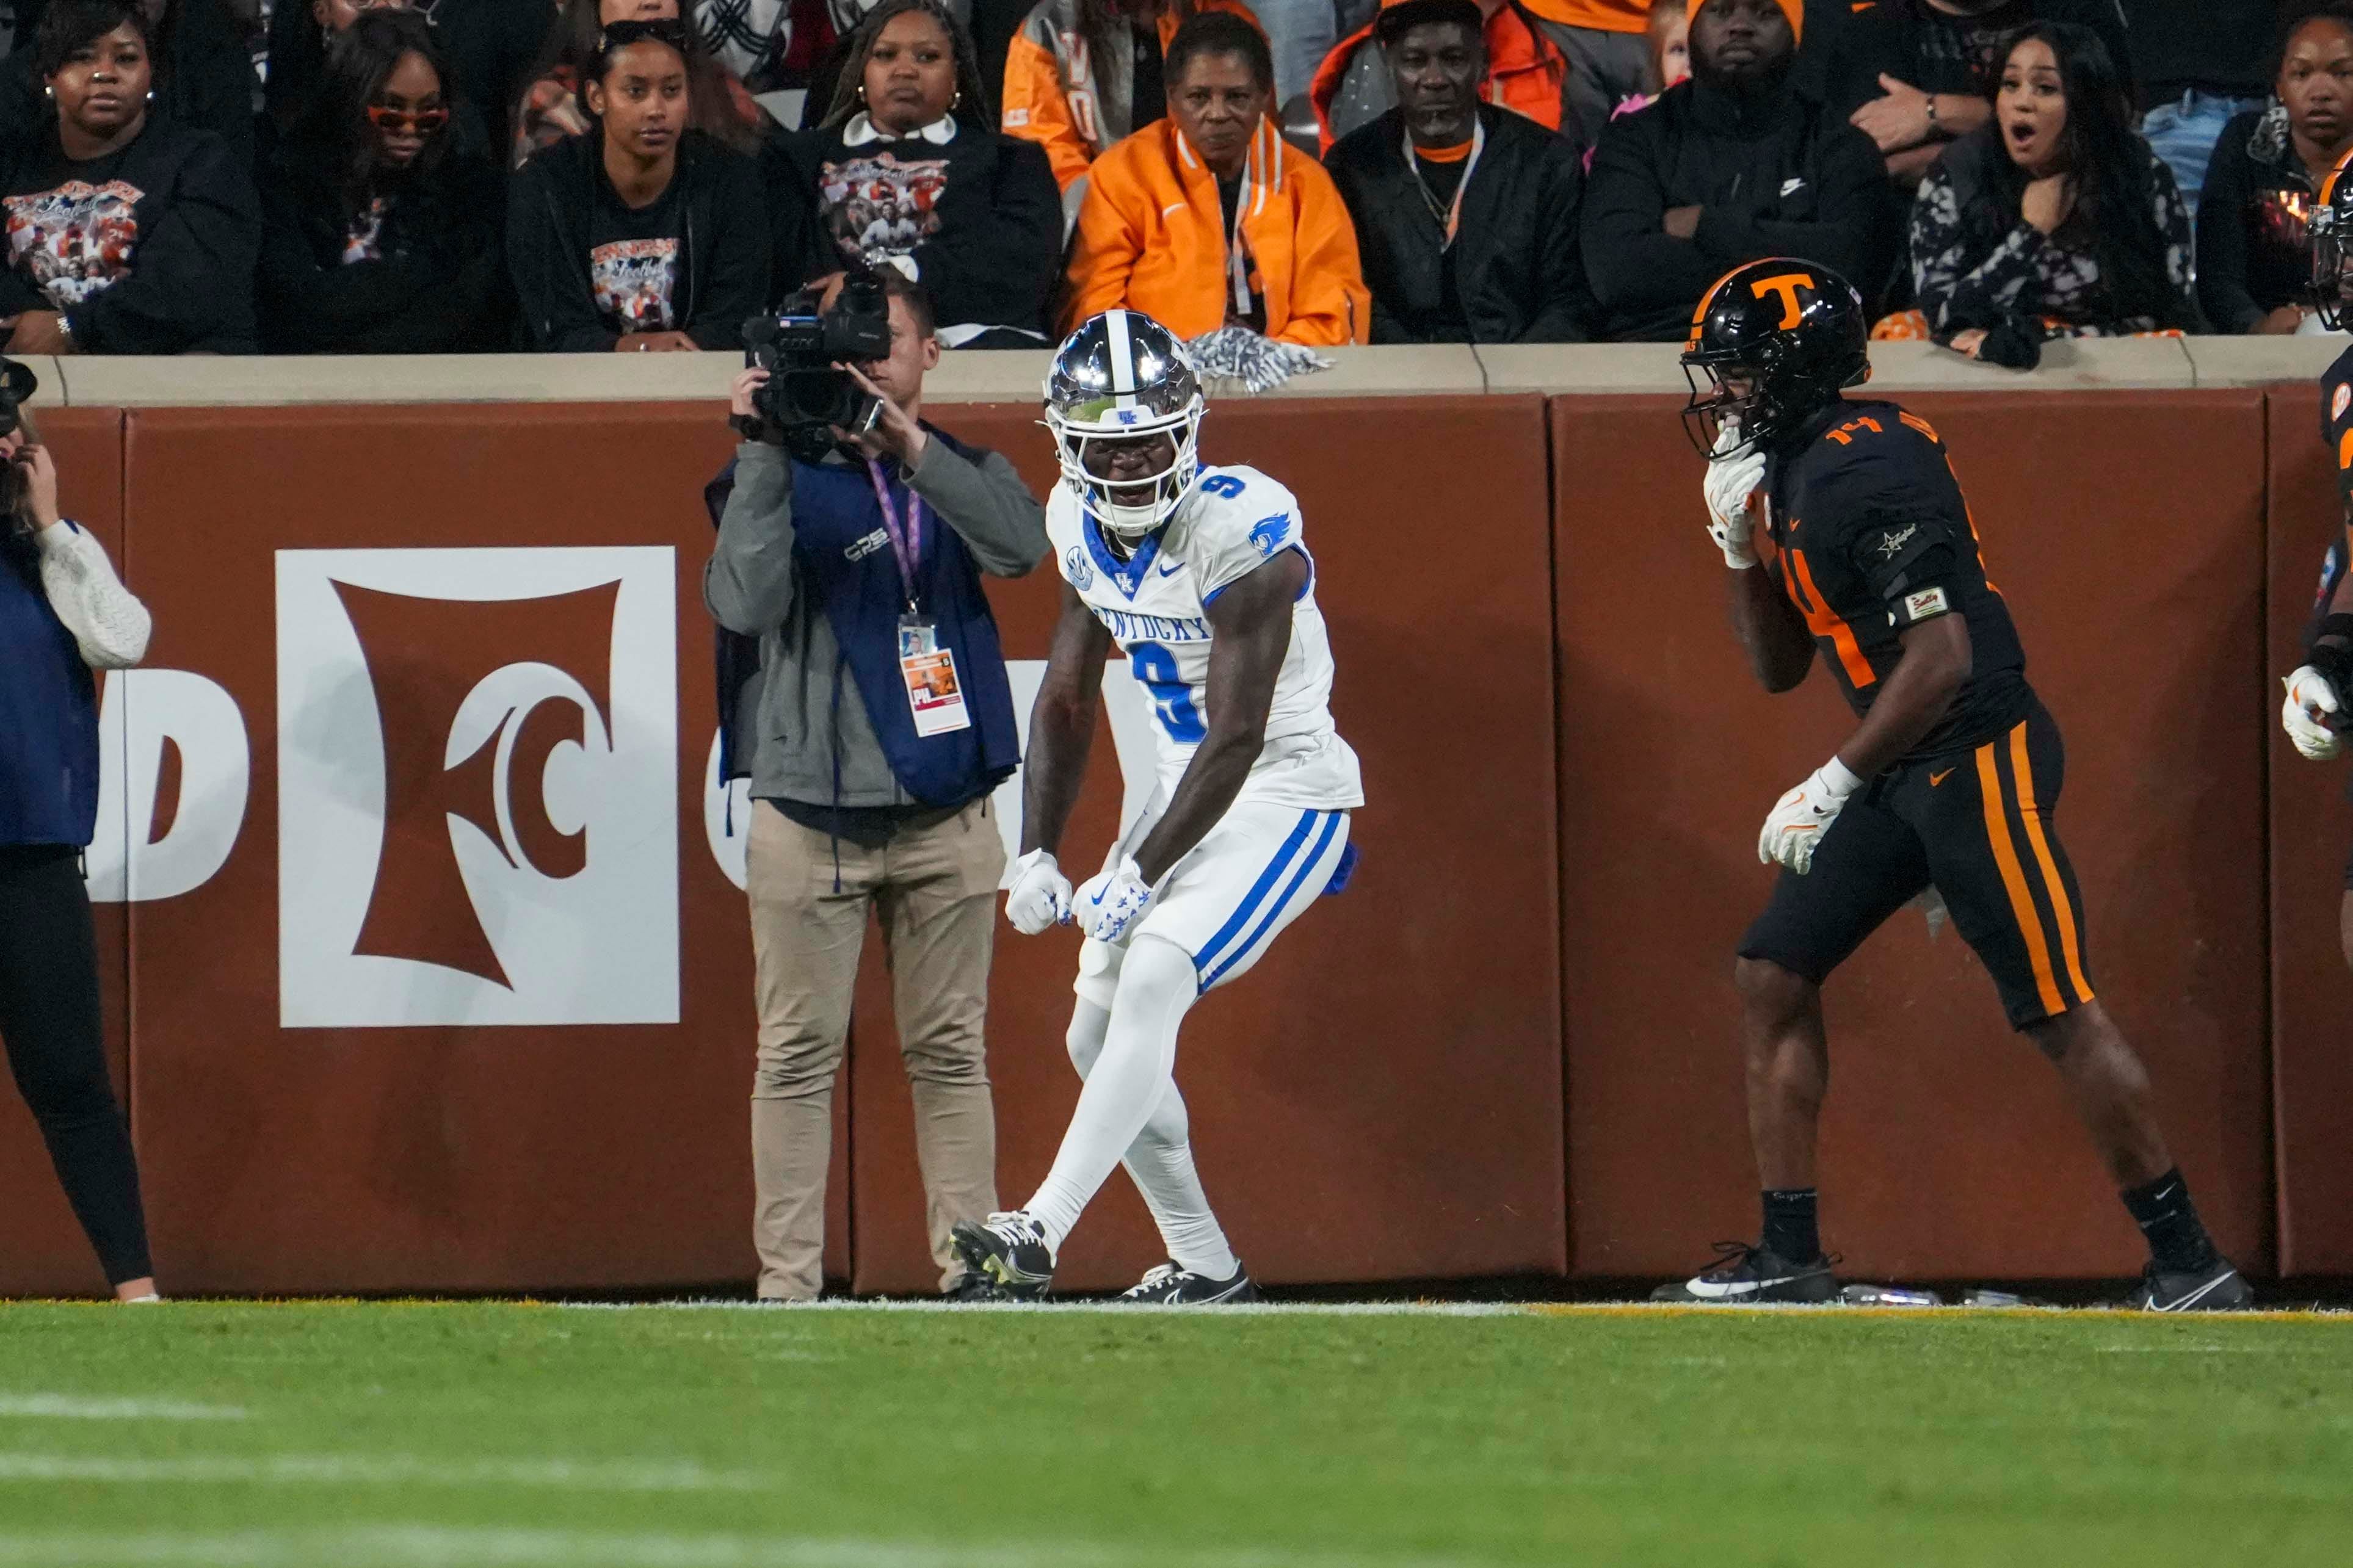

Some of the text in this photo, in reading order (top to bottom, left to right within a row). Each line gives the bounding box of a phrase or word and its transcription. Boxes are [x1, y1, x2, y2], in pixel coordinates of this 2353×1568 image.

[1750, 274, 1815, 330] T
[1825, 416, 1883, 446] 14
[1200, 474, 1247, 500] 9
[1114, 573, 1134, 593] UK
[1093, 608, 1209, 641] ENTUCKY
[1125, 640, 1209, 743] 9
